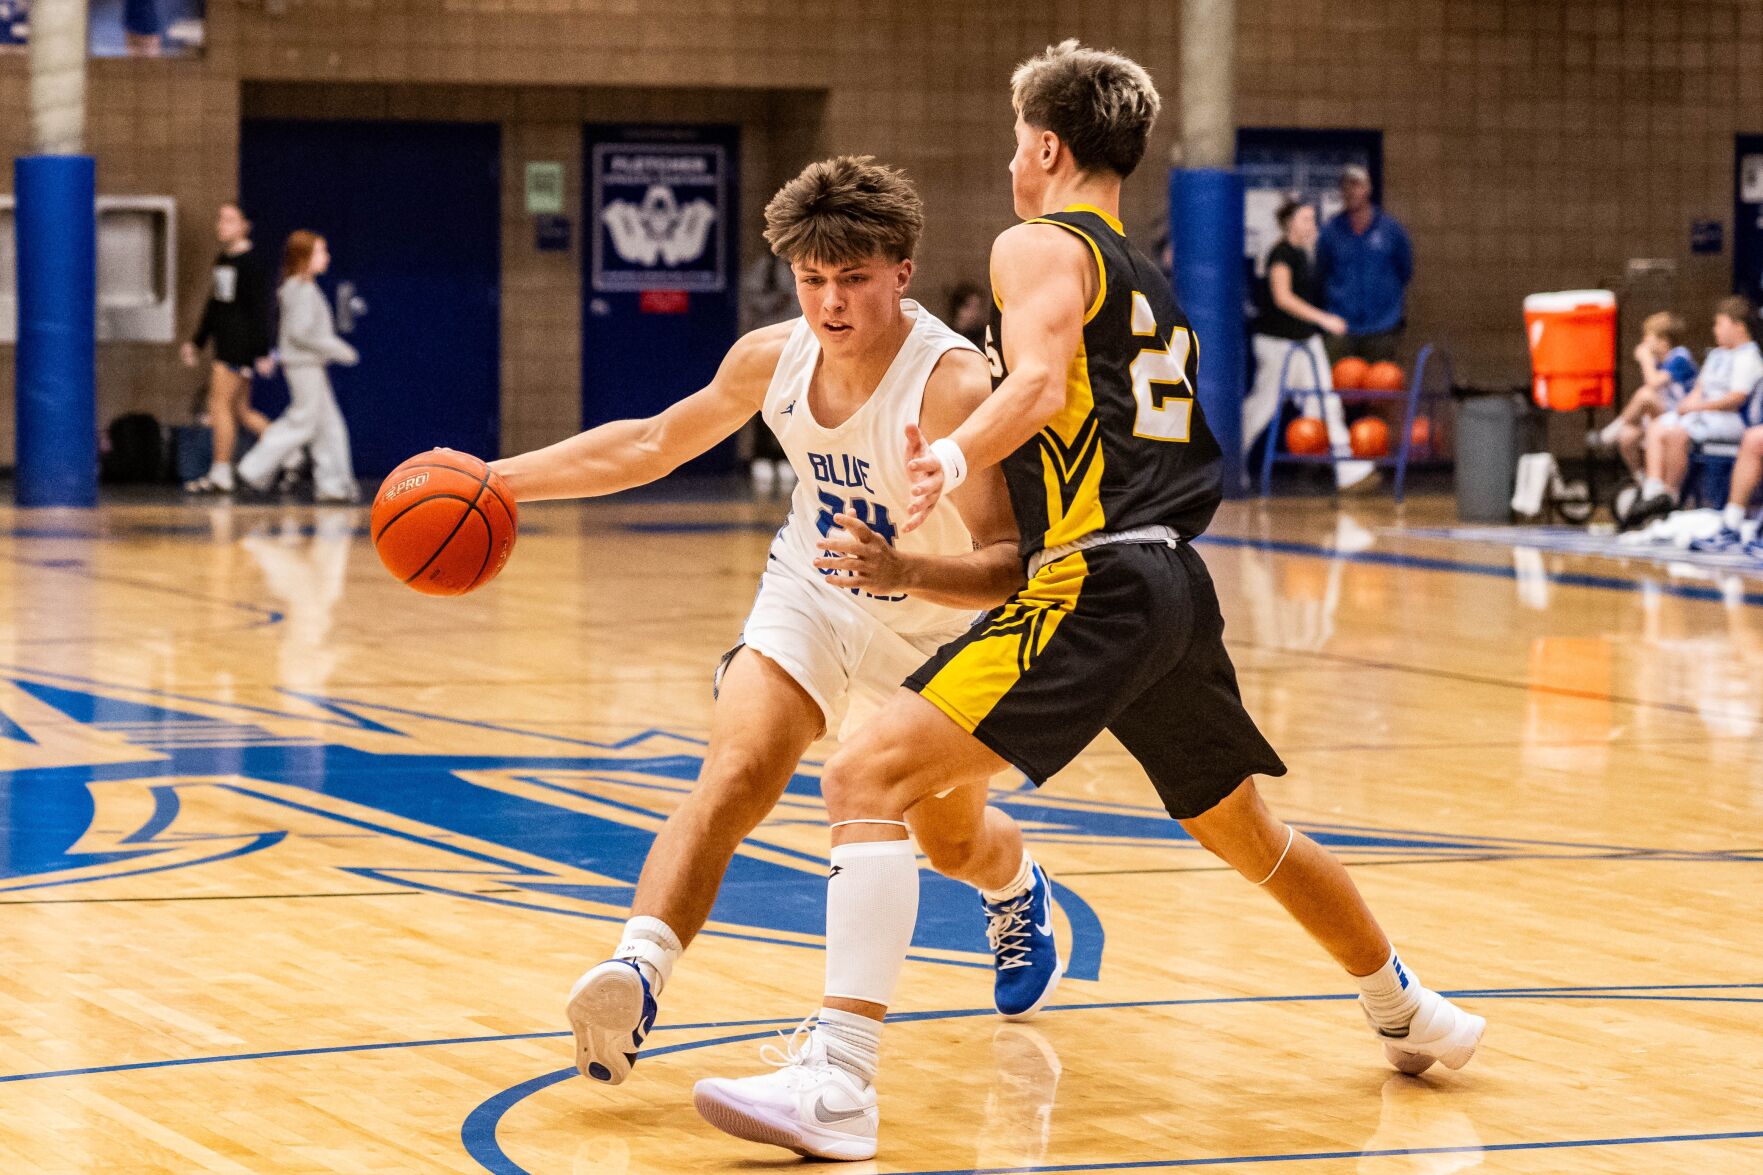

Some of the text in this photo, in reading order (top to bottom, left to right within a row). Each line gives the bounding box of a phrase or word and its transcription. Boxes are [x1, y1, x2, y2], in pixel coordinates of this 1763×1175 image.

[1129, 290, 1200, 443] 2
[807, 452, 875, 494] BLUE
[816, 487, 900, 550] 24
